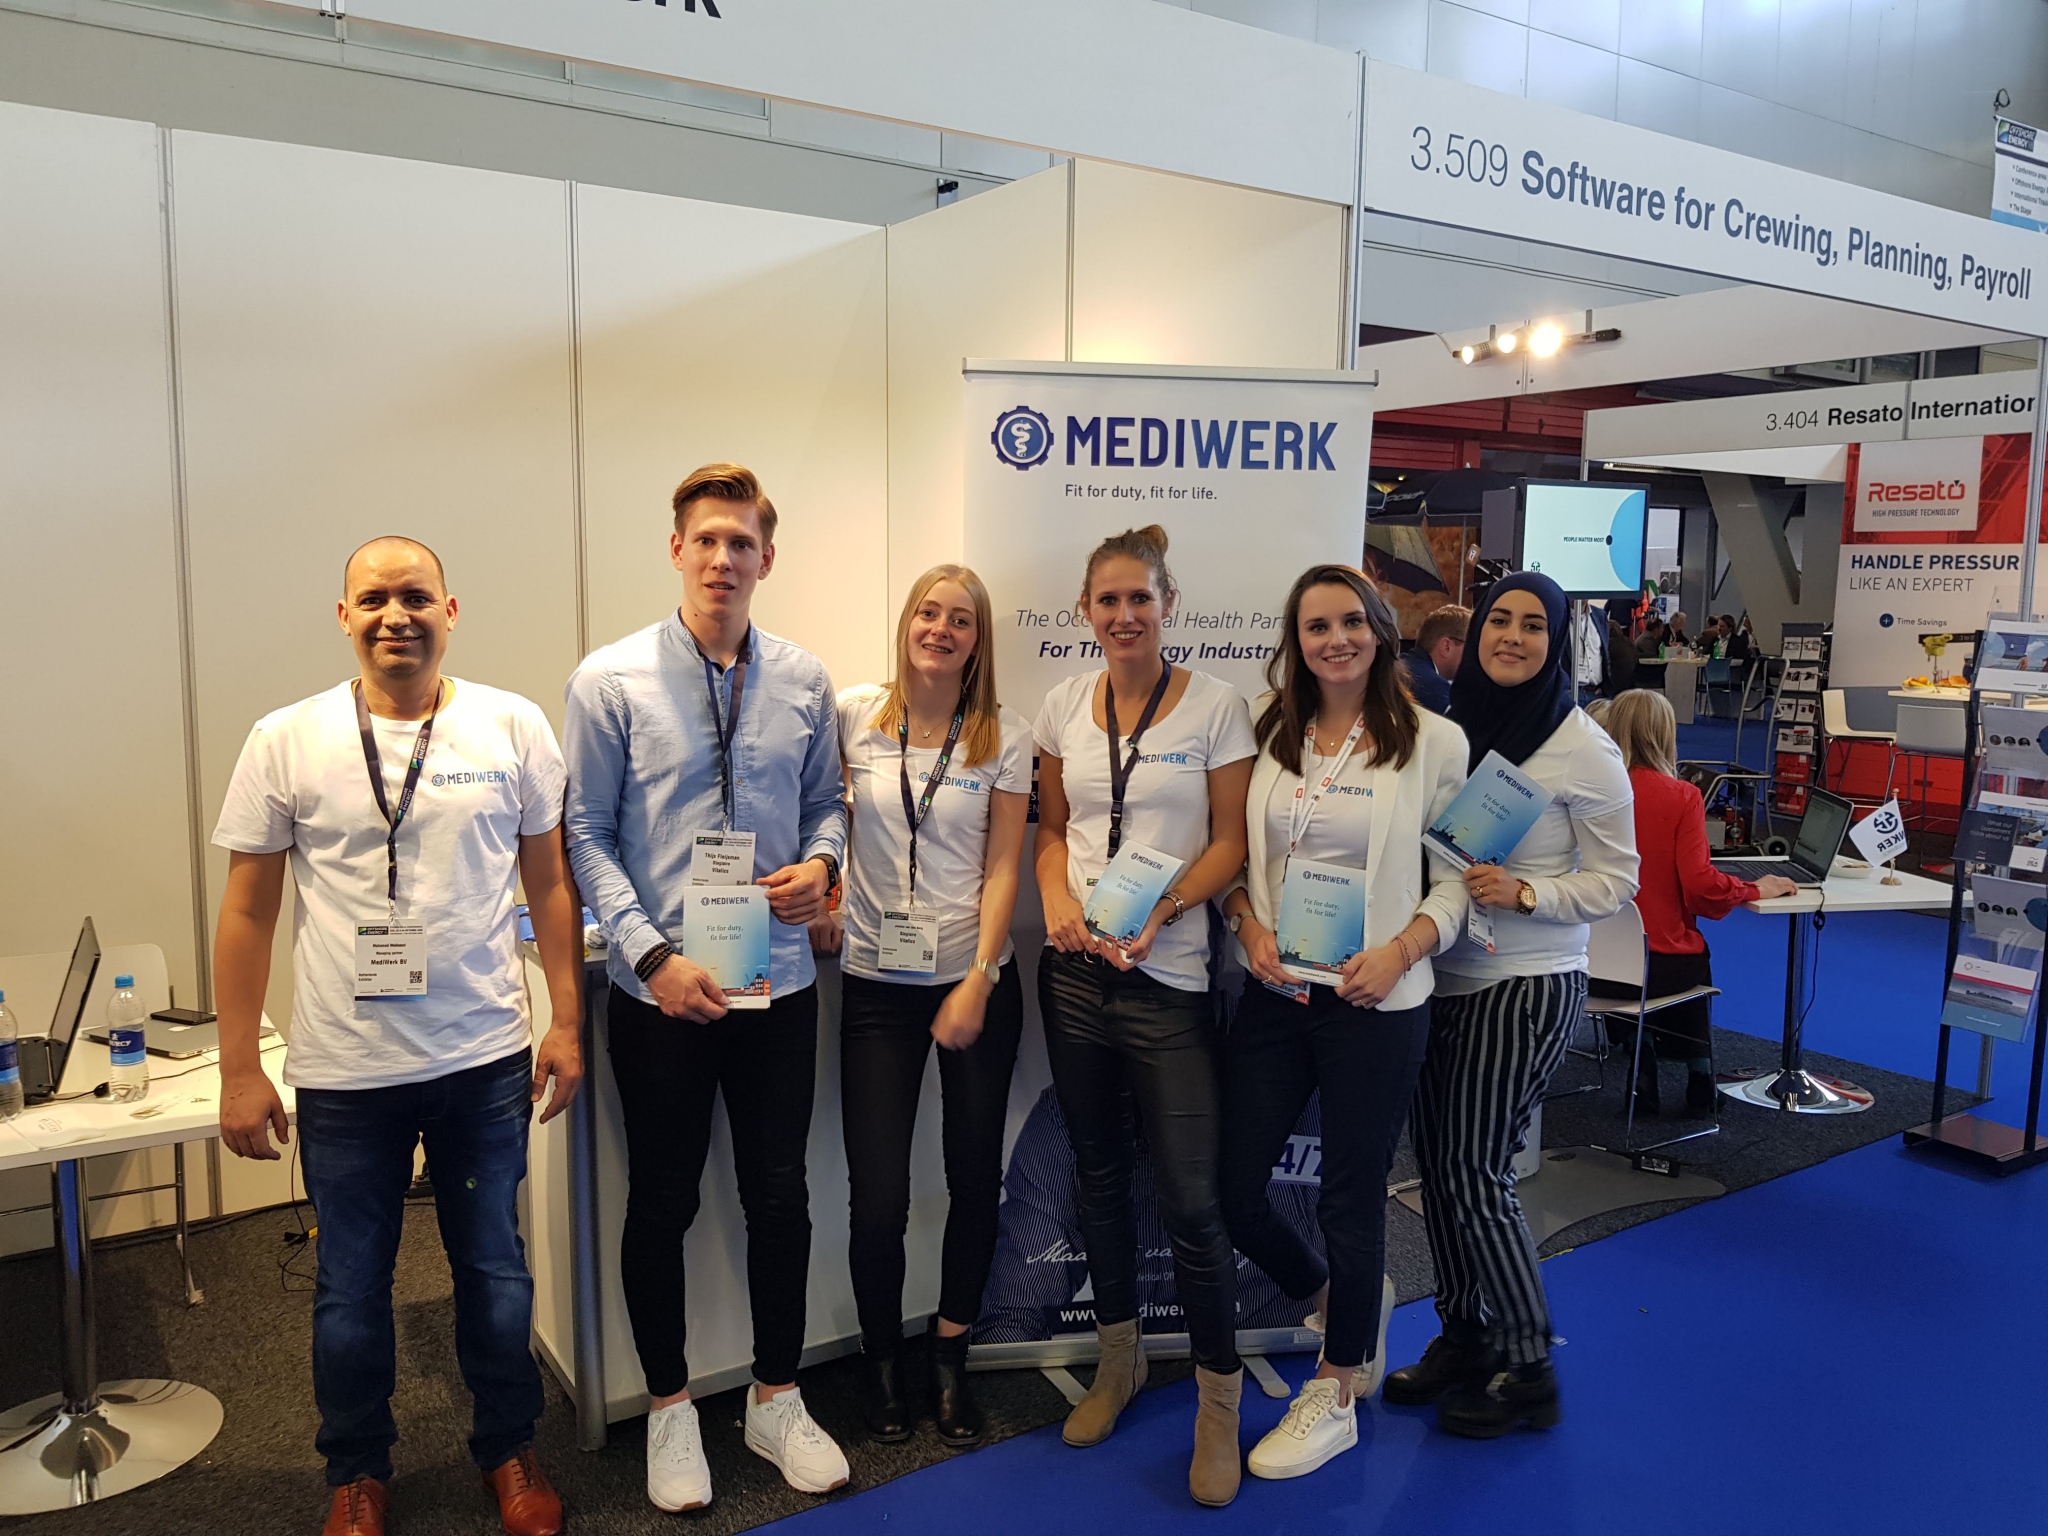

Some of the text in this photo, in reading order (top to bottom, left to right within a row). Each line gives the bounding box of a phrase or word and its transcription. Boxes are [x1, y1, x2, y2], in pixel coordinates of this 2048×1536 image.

[2008, 135, 2029, 148] ENERGY
[1411, 126, 2031, 301] 3.509 Software for Crewing, Planning, Payroll
[1766, 410, 1818, 431] 3.404
[1828, 405, 1903, 426] Resato
[1066, 415, 1338, 471] MEDIWERK
[1065, 484, 1217, 501] Fit for duty, fit for life.
[1868, 480, 1965, 502] Resato
[1888, 509, 1918, 517] PRESSURE
[1851, 554, 2019, 570] HANDLE PRESSUR
[1849, 577, 1974, 592] LIKE AN EXPERT
[1016, 609, 1049, 627] The
[1184, 611, 1243, 629] Health
[1250, 613, 1287, 629] Part
[1897, 618, 1947, 628] Time Savings
[1039, 641, 1072, 658] For
[1079, 641, 1106, 658] Th
[1161, 645, 1193, 663] rgy
[418, 738, 428, 760] ENERGY
[1138, 753, 1188, 765] MEDIWERK
[447, 771, 508, 785] MEDIWERK
[940, 776, 981, 792] EDIWERK
[1339, 786, 1373, 797] MEDIW
[1502, 775, 1535, 800] MEDIWERK
[402, 789, 413, 811] ENERGY
[1484, 793, 1492, 802] Fit
[1491, 797, 1500, 808] for
[1480, 802, 1488, 811] fit
[1487, 806, 1496, 815] for
[1136, 854, 1164, 871] MEDIWERK
[1312, 873, 1350, 886] MEDIWERK
[711, 897, 750, 905] MEDIWERK
[1313, 899, 1323, 907] for
[1324, 901, 1340, 911] duty,
[1306, 907, 1314, 915] fit
[1324, 910, 1337, 918] life!
[1277, 1143, 1321, 1176] 4/7
